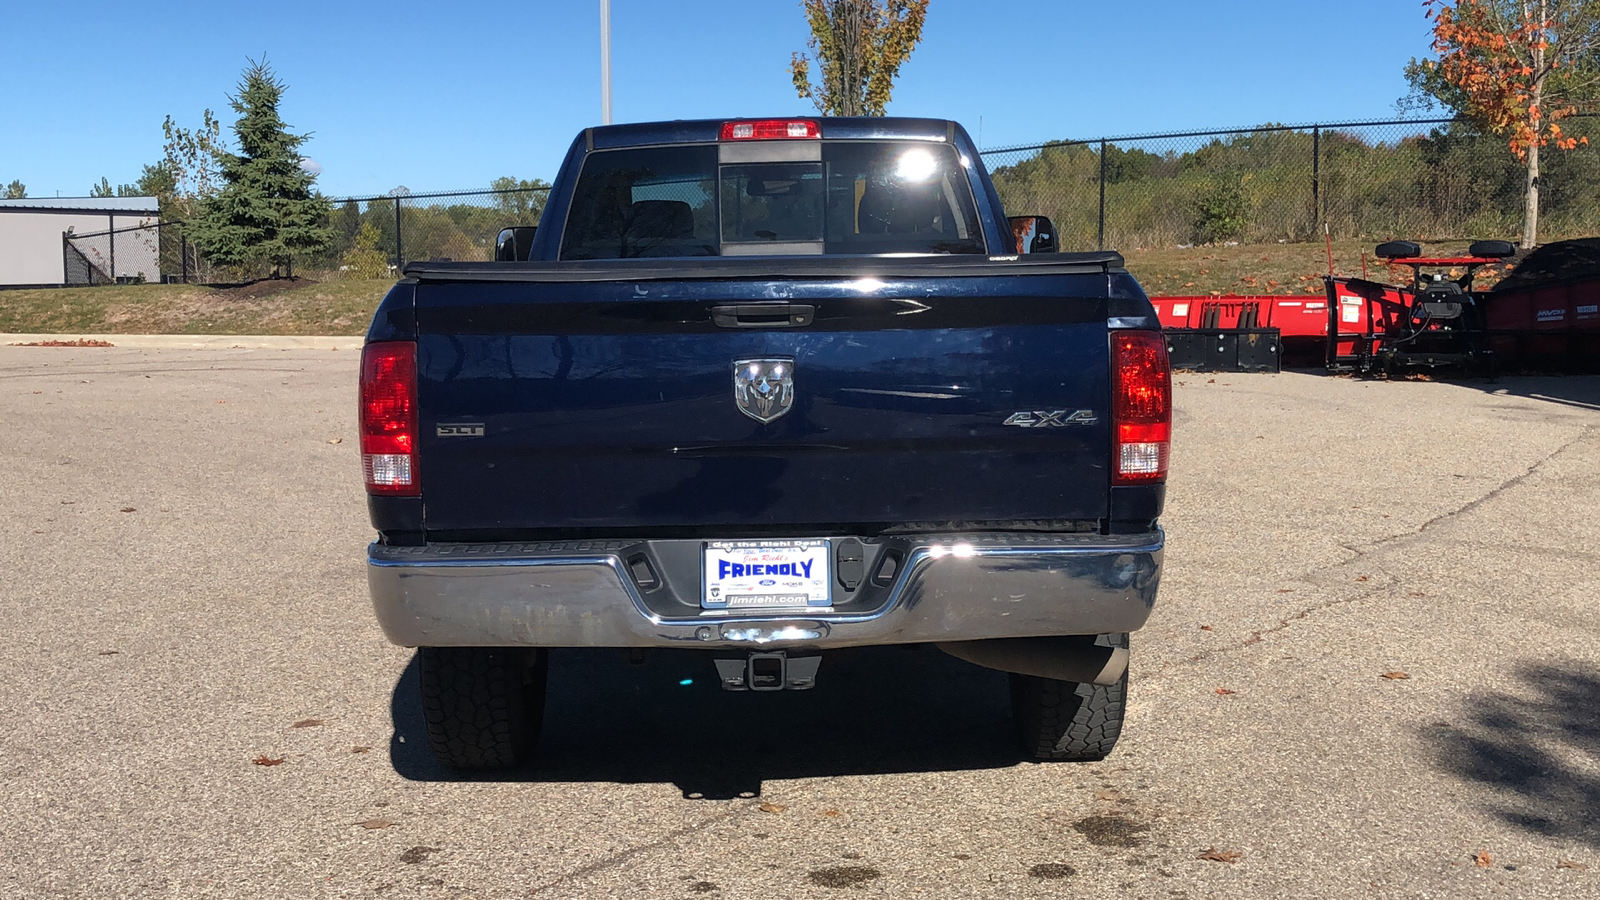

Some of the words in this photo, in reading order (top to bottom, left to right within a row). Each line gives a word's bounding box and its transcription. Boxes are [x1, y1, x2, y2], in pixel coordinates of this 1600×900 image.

[437, 423, 485, 437] SLT
[719, 558, 814, 580] FRIENDLY
[729, 595, 806, 606] jimriehl.com
